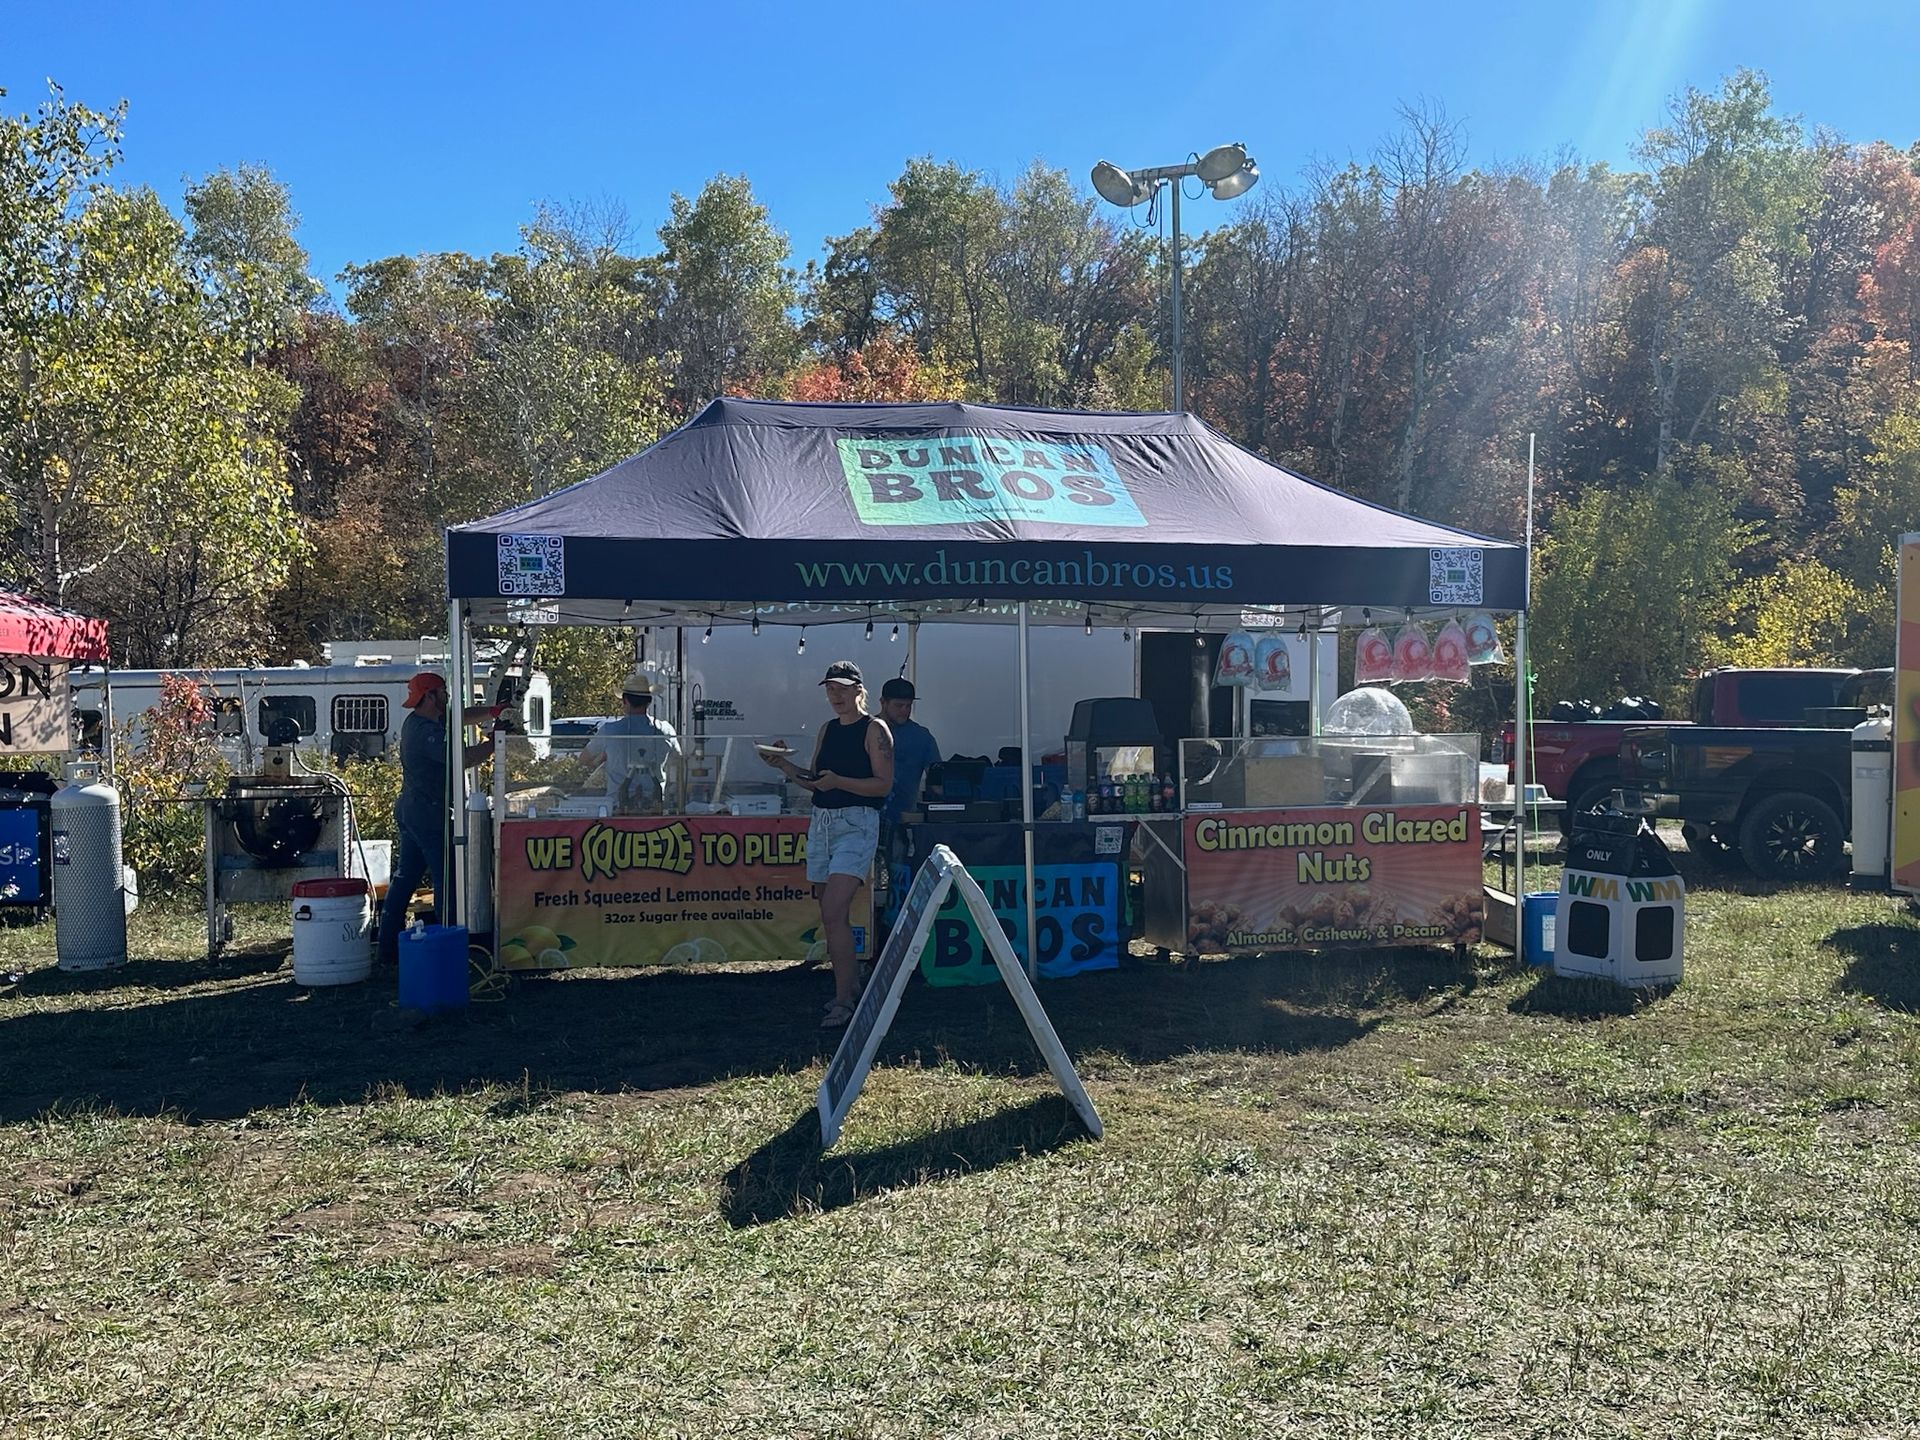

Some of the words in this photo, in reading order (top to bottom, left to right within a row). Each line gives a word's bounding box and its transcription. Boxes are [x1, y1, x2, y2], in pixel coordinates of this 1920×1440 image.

[858, 446, 1099, 472] DUNCAN
[865, 470, 1116, 506] BROS
[795, 550, 1233, 590] www.duncanbros.us
[1195, 818, 1354, 851] Cinnamon
[1361, 810, 1468, 844] Glazed
[526, 837, 572, 870] WE
[581, 821, 695, 882] SQUEEZE
[700, 833, 739, 866] TO
[744, 833, 809, 866] PLEA
[1586, 849, 1612, 862] ONLY
[1297, 851, 1371, 884] Nuts
[534, 888, 579, 907] Fresh
[585, 887, 661, 908] Squeezed
[666, 886, 751, 904] Lemonade
[1568, 874, 1620, 902] WM
[1626, 880, 1682, 903] WM
[604, 912, 635, 924] 32oz
[639, 911, 678, 924] Sugar
[681, 909, 708, 921] free
[711, 909, 774, 921] available
[1226, 930, 1298, 946] Almonds,
[1302, 927, 1372, 943] Cashews,
[1376, 926, 1388, 938] &
[1393, 924, 1446, 938] Pecans
